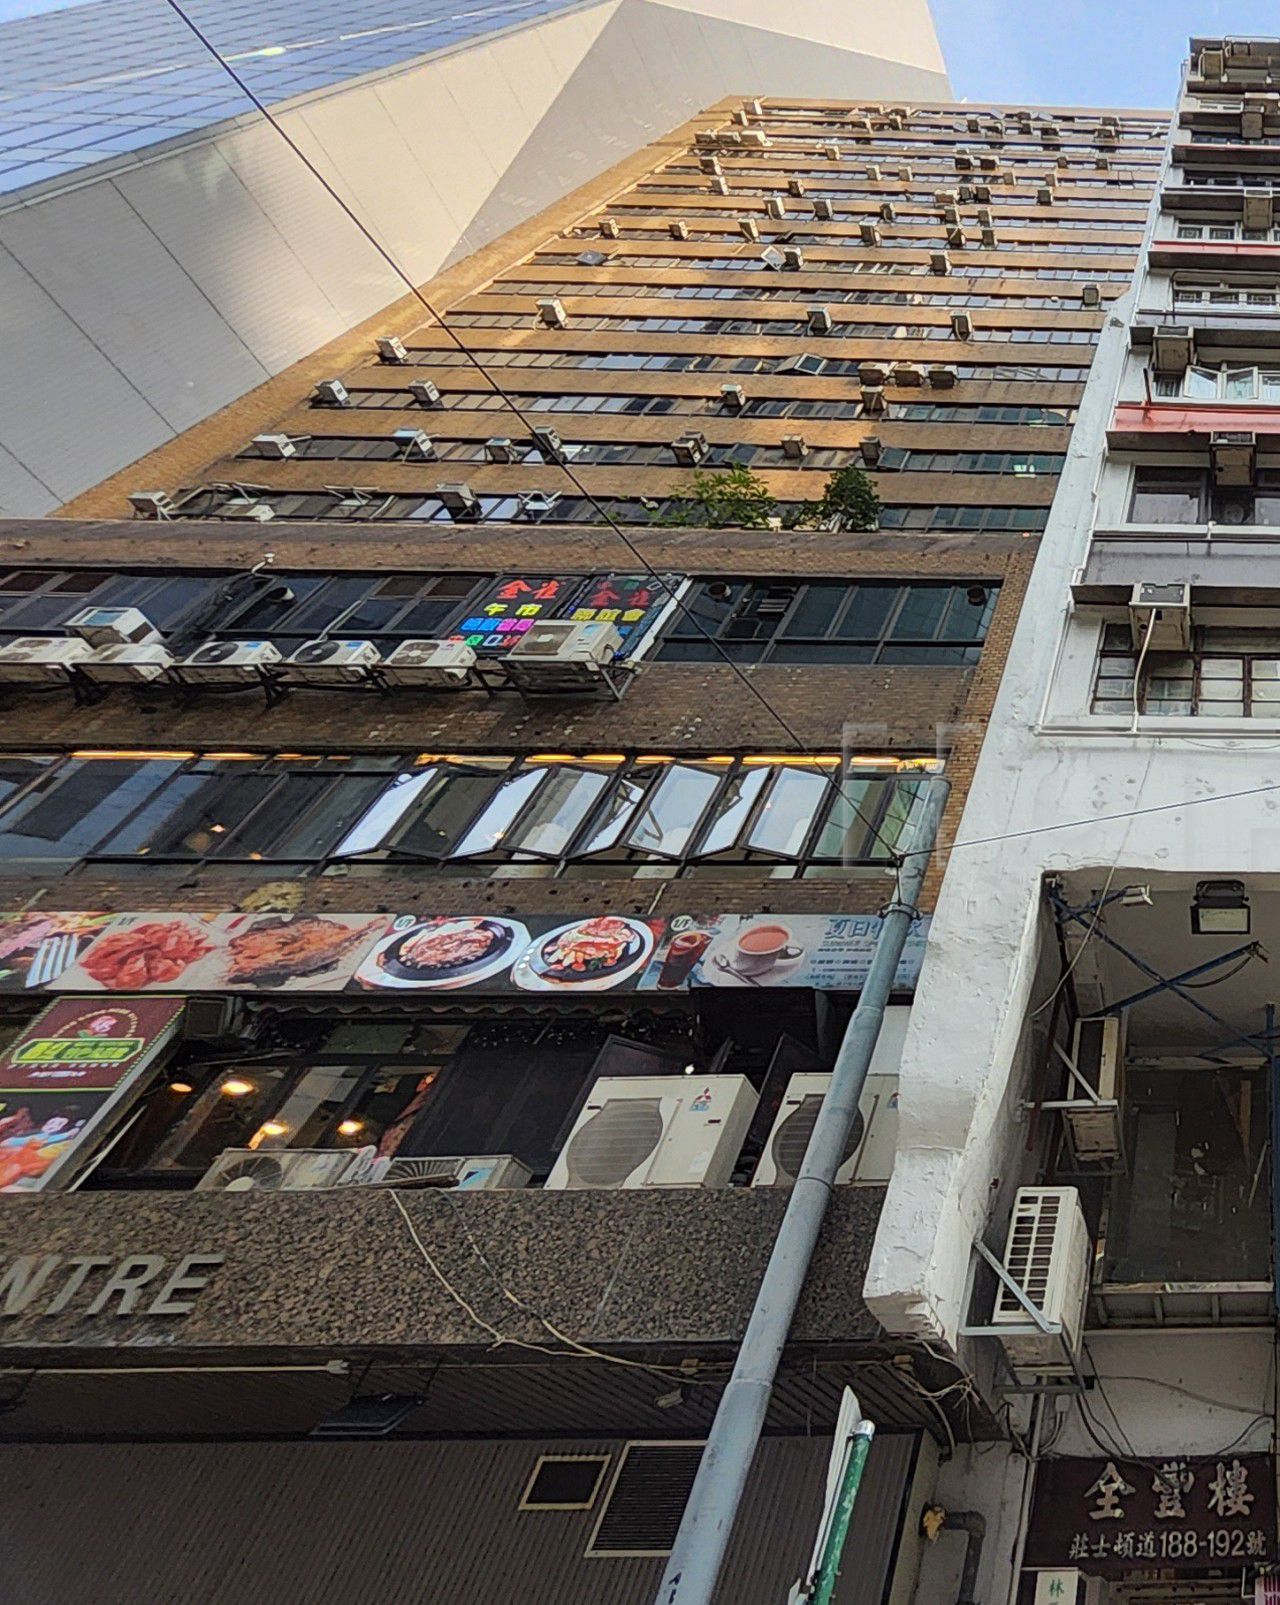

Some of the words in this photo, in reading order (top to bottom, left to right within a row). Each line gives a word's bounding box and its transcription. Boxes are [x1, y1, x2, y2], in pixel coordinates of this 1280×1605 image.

[673, 918, 690, 929] 1/F
[1069, 1528, 1267, 1560] 莊士頓道188-192號
